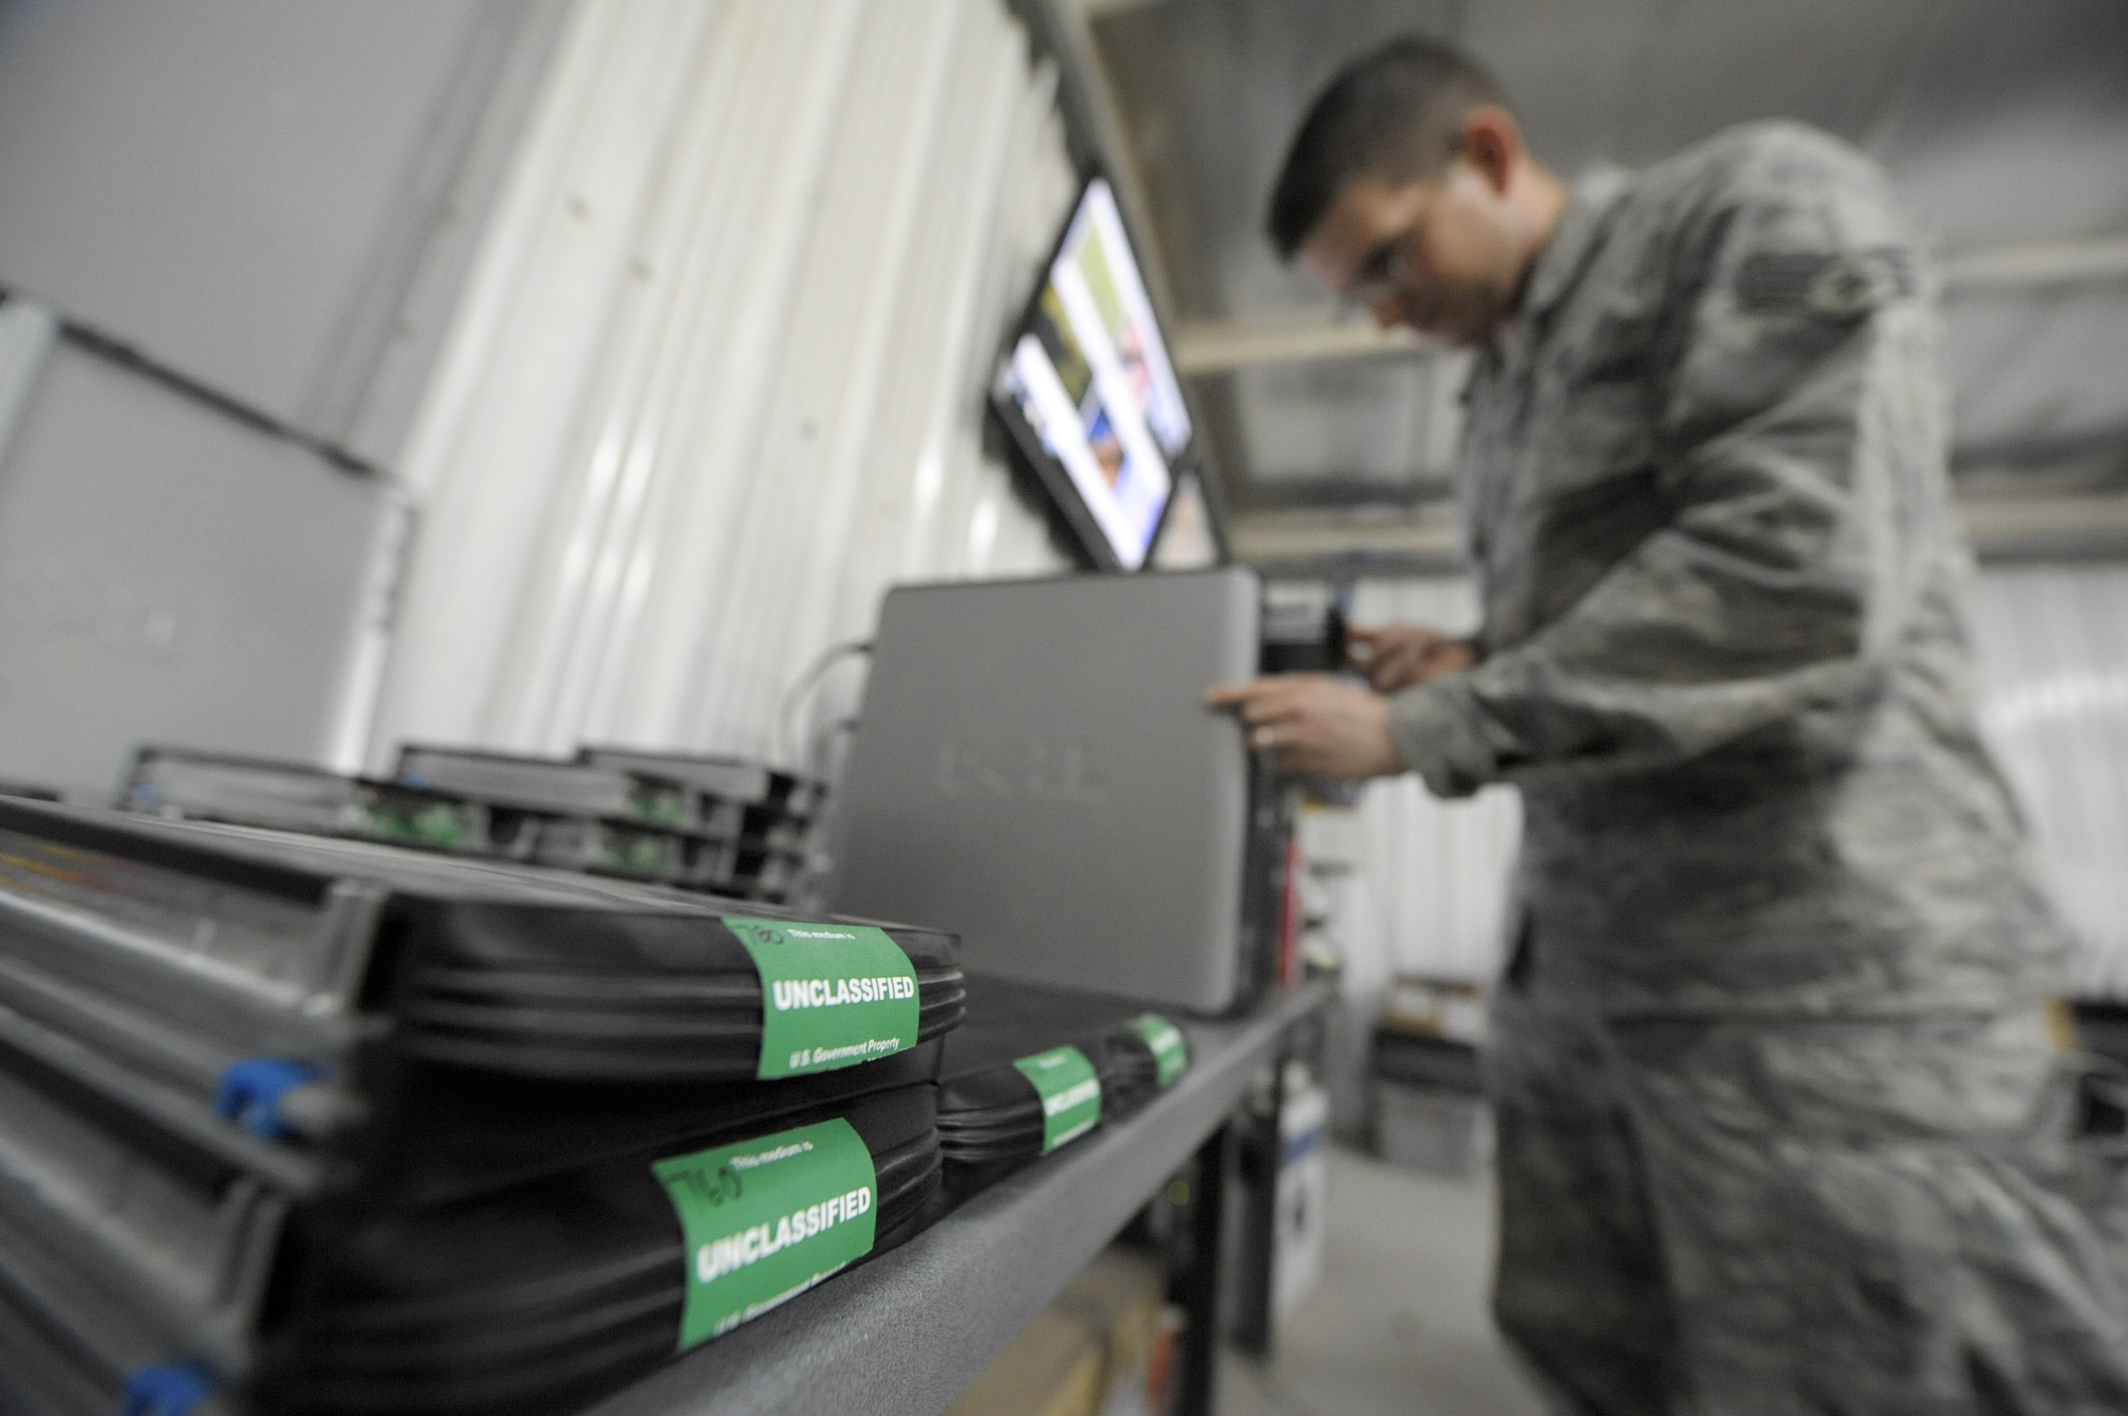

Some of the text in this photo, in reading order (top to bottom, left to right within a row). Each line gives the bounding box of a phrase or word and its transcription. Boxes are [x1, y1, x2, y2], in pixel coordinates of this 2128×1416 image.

[787, 928, 856, 940] This medium is
[772, 976, 915, 1011] UNCLASSIFIED
[812, 1041, 867, 1065] Government
[867, 1036, 900, 1053] Property
[759, 1142, 803, 1164] medium
[802, 1140, 814, 1151] is
[695, 1186, 871, 1284] UNCLASSIFIED
